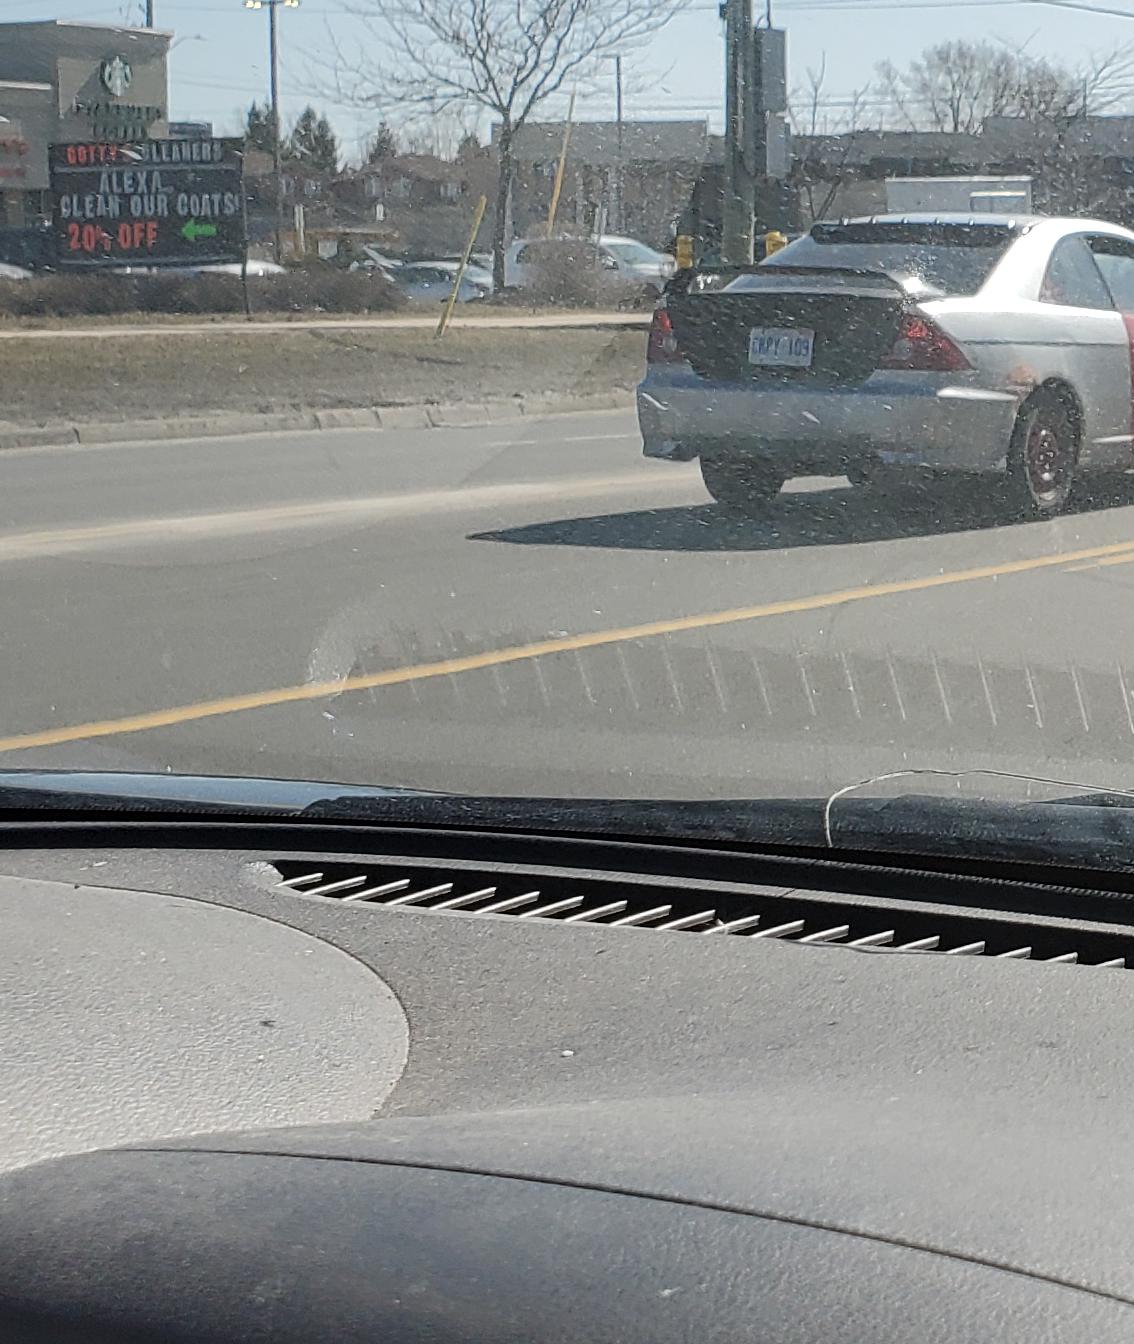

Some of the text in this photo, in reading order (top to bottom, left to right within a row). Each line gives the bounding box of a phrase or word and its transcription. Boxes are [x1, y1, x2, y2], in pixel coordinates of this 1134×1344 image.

[60, 193, 120, 218] CLEAN
[130, 193, 168, 217] OUR
[118, 220, 158, 249] OFF
